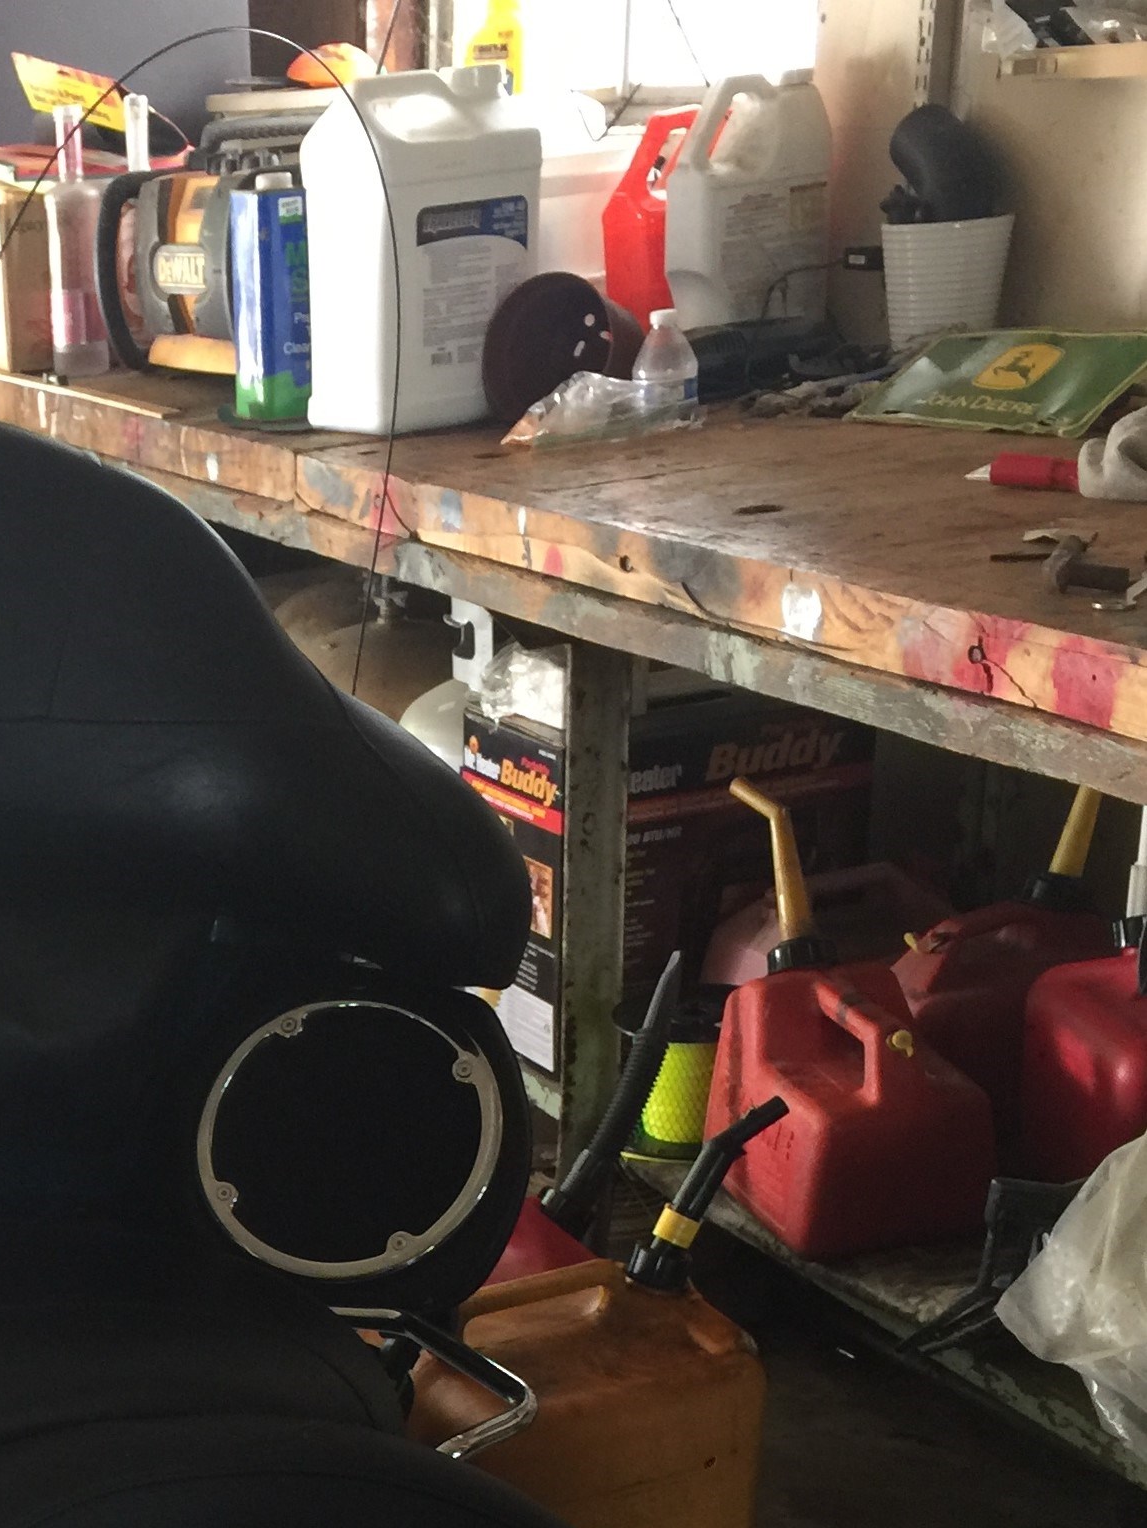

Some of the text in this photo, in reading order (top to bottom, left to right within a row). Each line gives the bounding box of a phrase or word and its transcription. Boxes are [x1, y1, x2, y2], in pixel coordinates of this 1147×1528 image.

[969, 395, 1041, 415] DEERE
[500, 758, 558, 807] Buddy
[628, 729, 844, 794] eater Buddy
